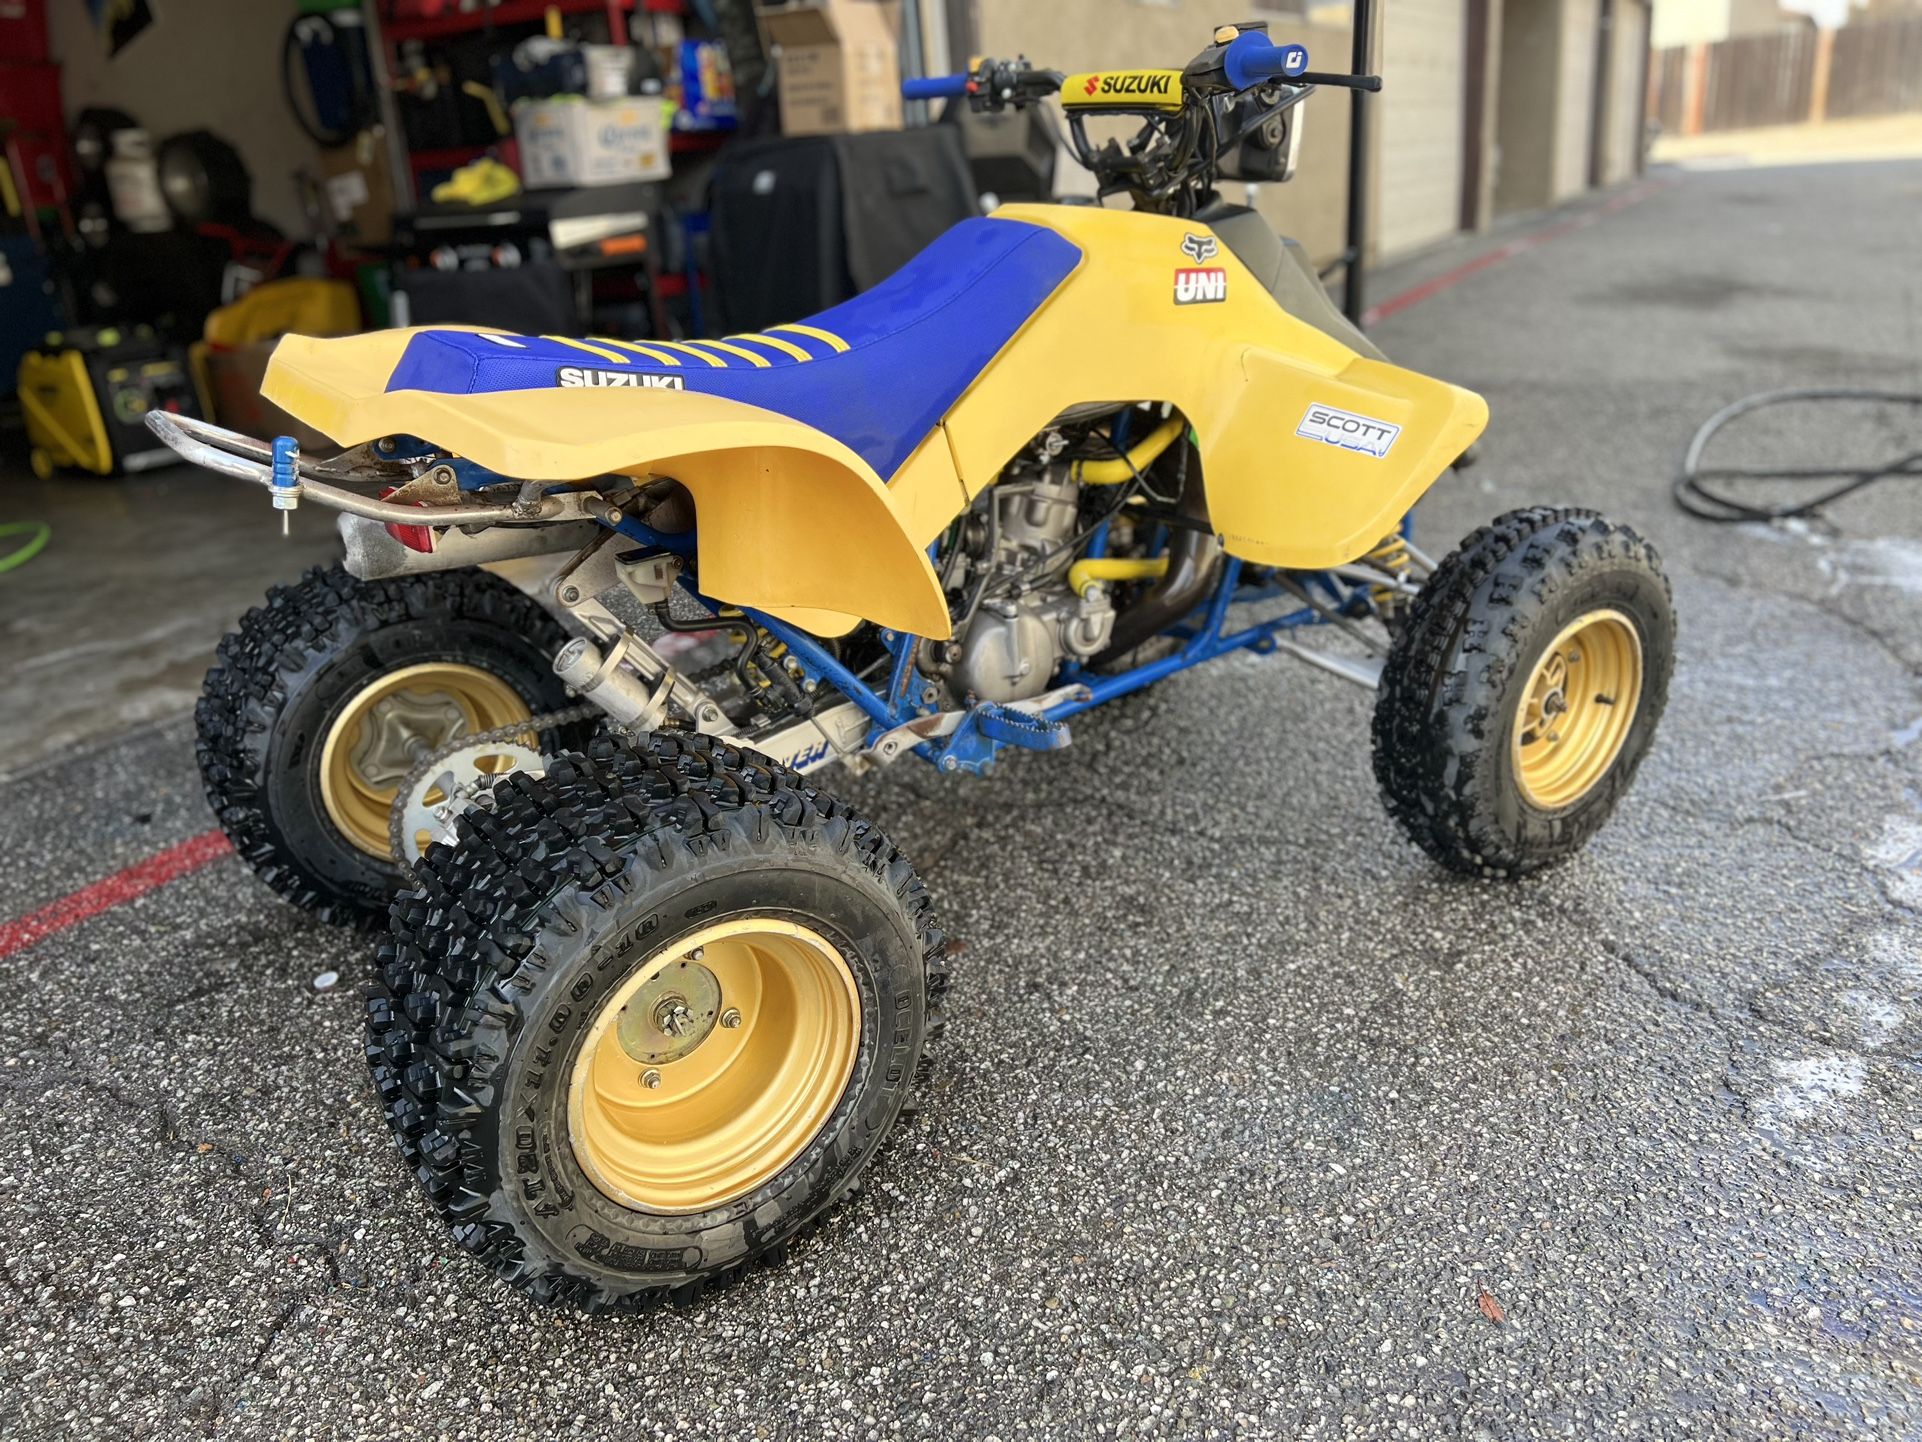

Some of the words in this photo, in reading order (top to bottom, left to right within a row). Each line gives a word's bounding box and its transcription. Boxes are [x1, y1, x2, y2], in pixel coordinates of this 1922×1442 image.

[1101, 75, 1172, 95] SUZUKI
[1176, 271, 1225, 302] UNI
[559, 366, 684, 391] SUZUKI
[1308, 411, 1393, 441] SCOTT
